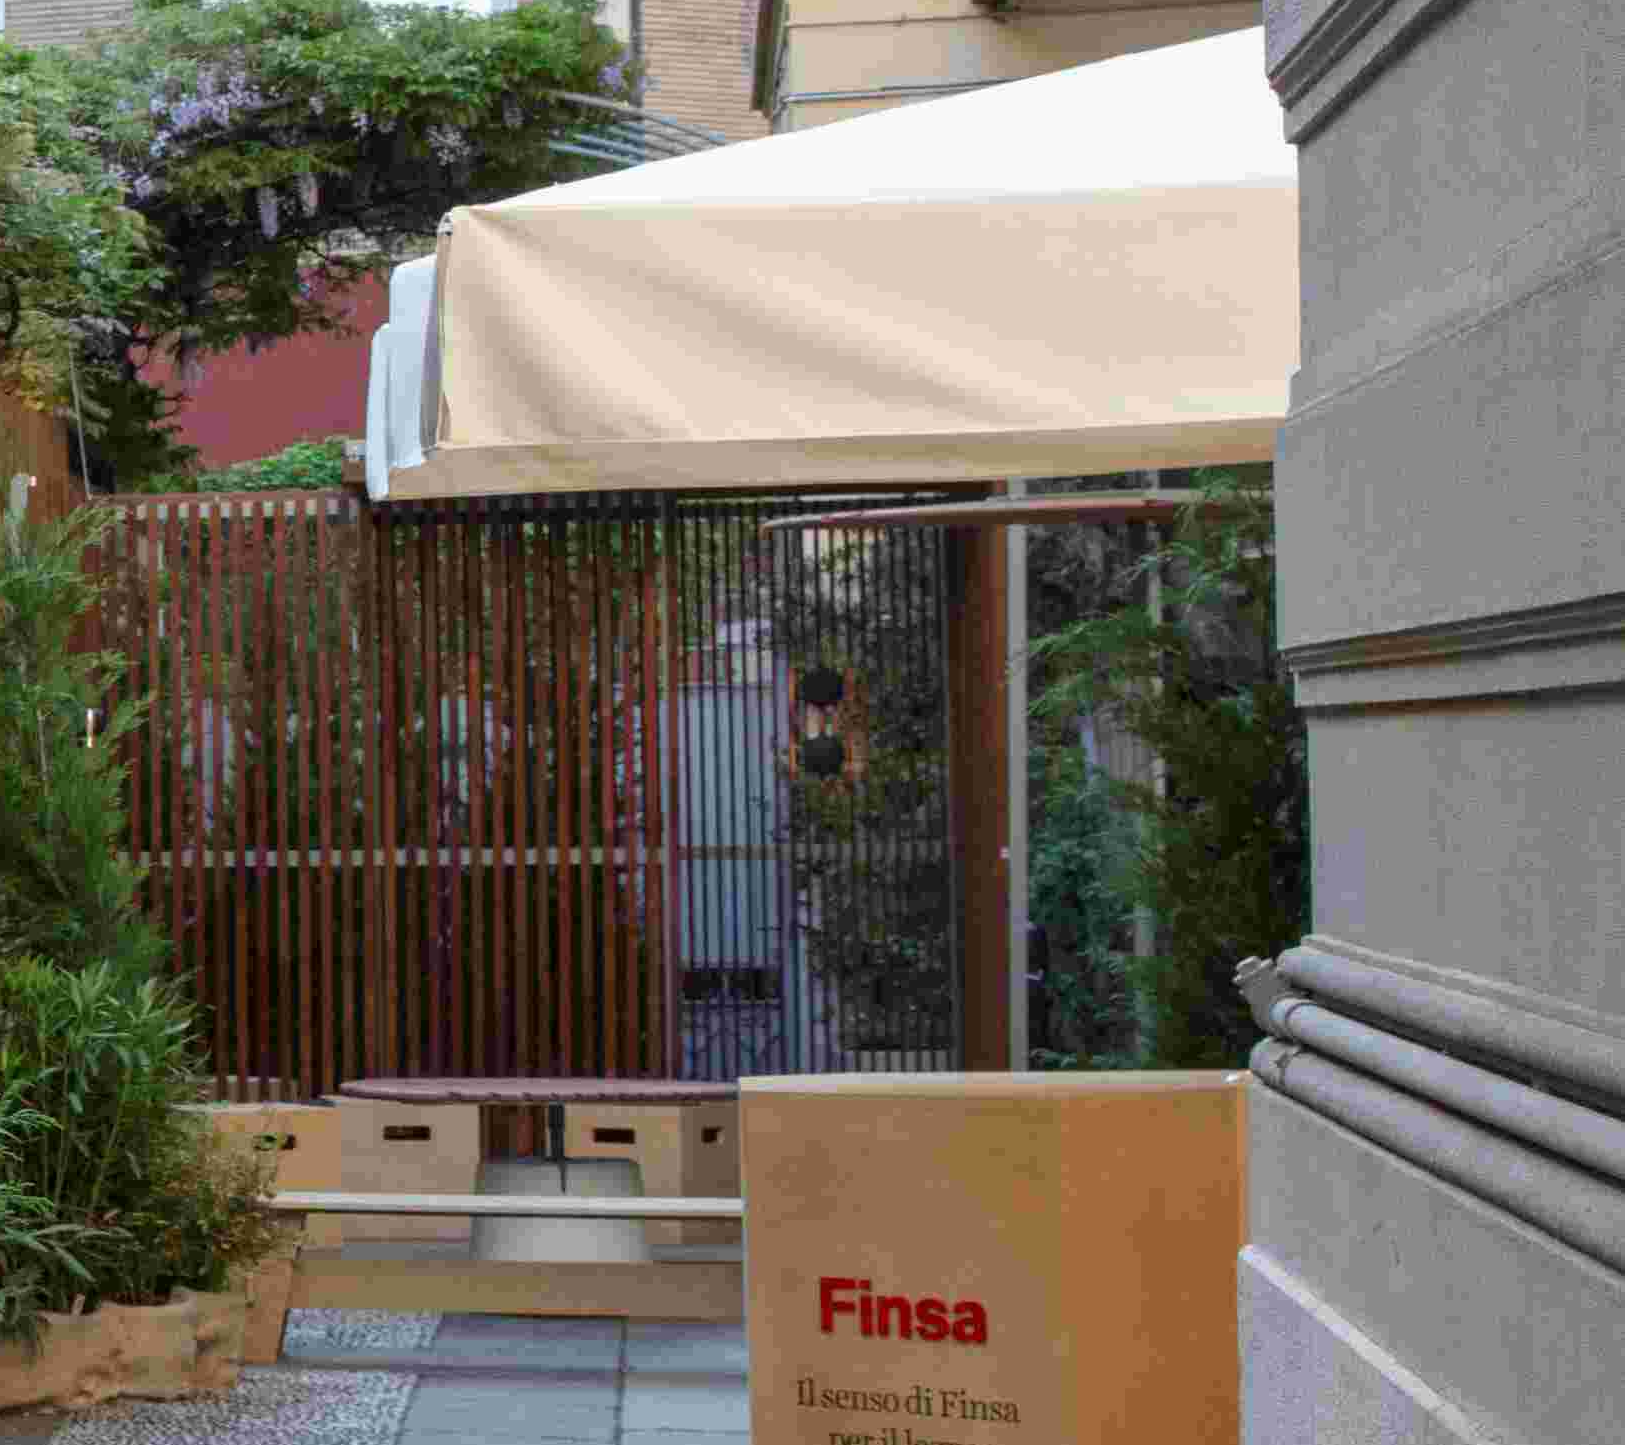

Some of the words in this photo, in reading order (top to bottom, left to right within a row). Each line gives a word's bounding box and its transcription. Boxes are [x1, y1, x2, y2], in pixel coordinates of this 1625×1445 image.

[818, 1276, 988, 1345] Finsa
[797, 1378, 815, 1407] Il
[820, 1387, 901, 1413] senso
[904, 1384, 934, 1417] di
[938, 1388, 1021, 1424] Finsa
